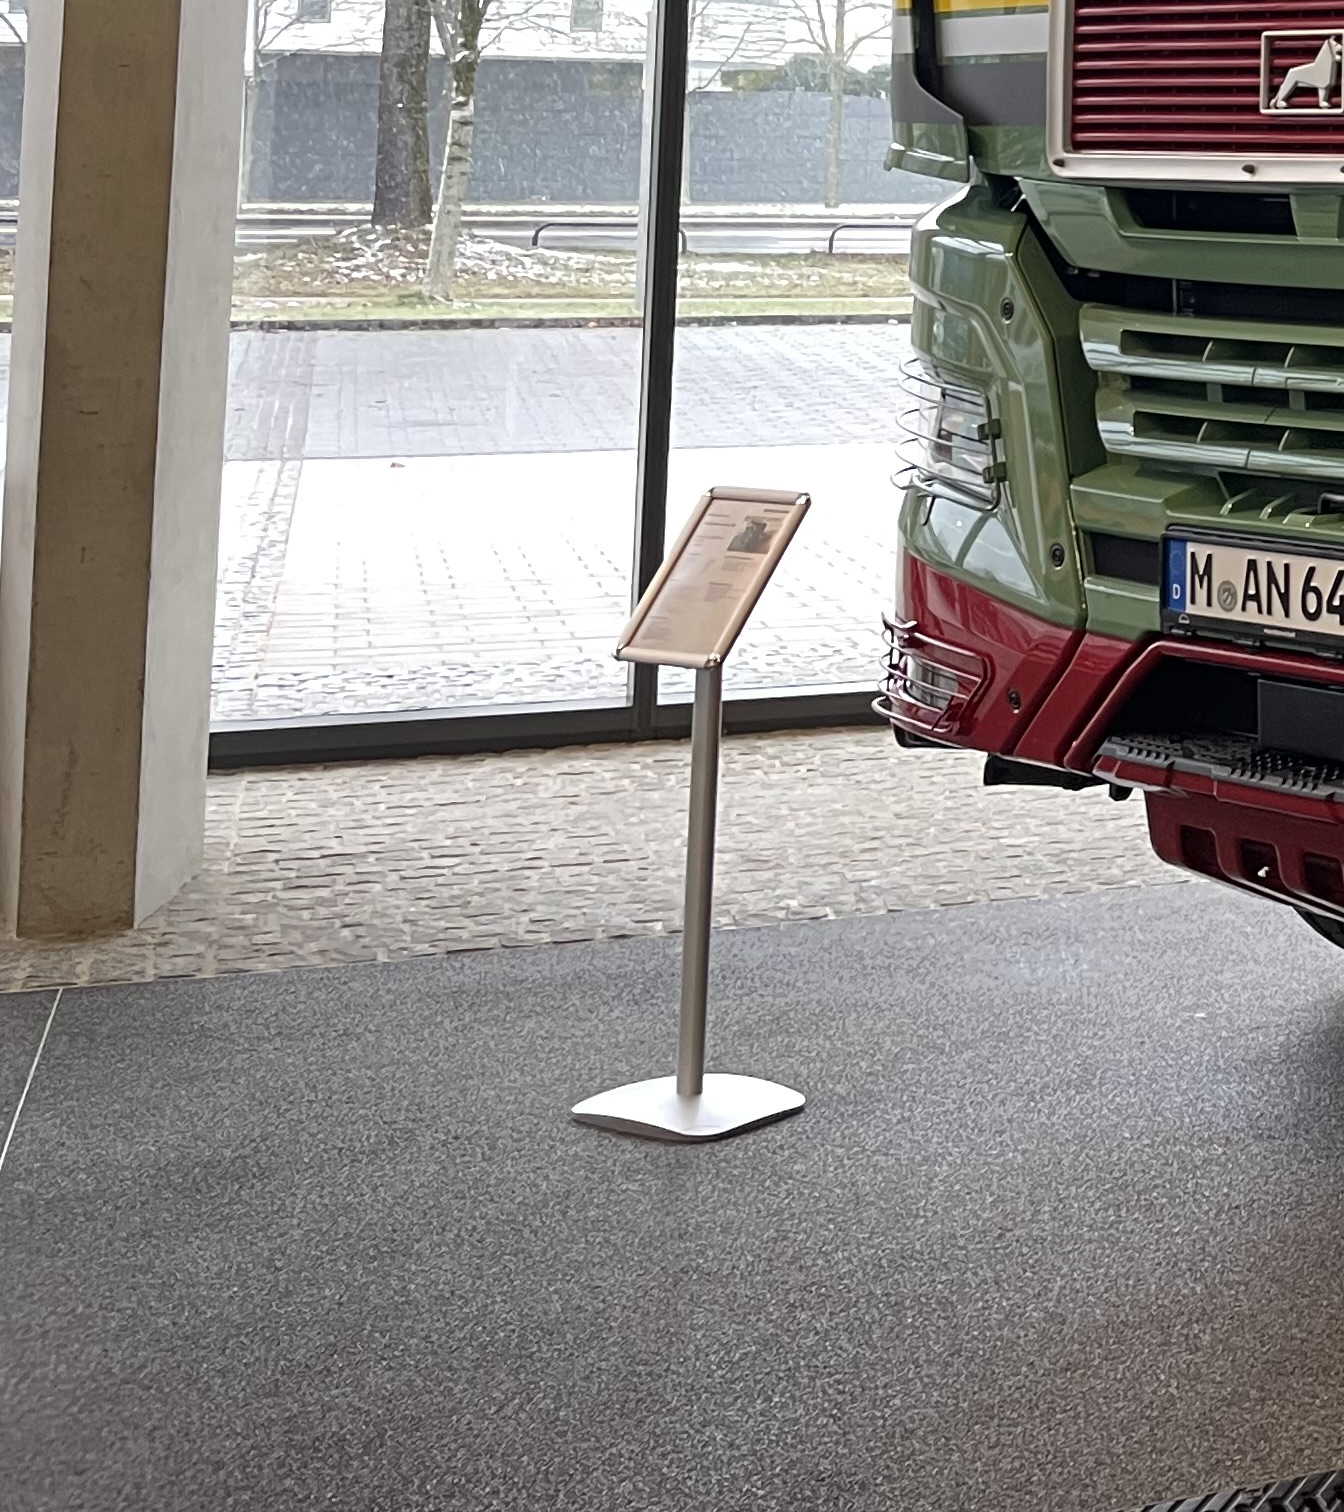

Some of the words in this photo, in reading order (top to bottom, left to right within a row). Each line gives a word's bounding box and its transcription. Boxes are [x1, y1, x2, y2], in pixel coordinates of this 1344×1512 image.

[1171, 583, 1181, 600] D
[1189, 550, 1213, 608] M
[1240, 557, 1291, 619] AN
